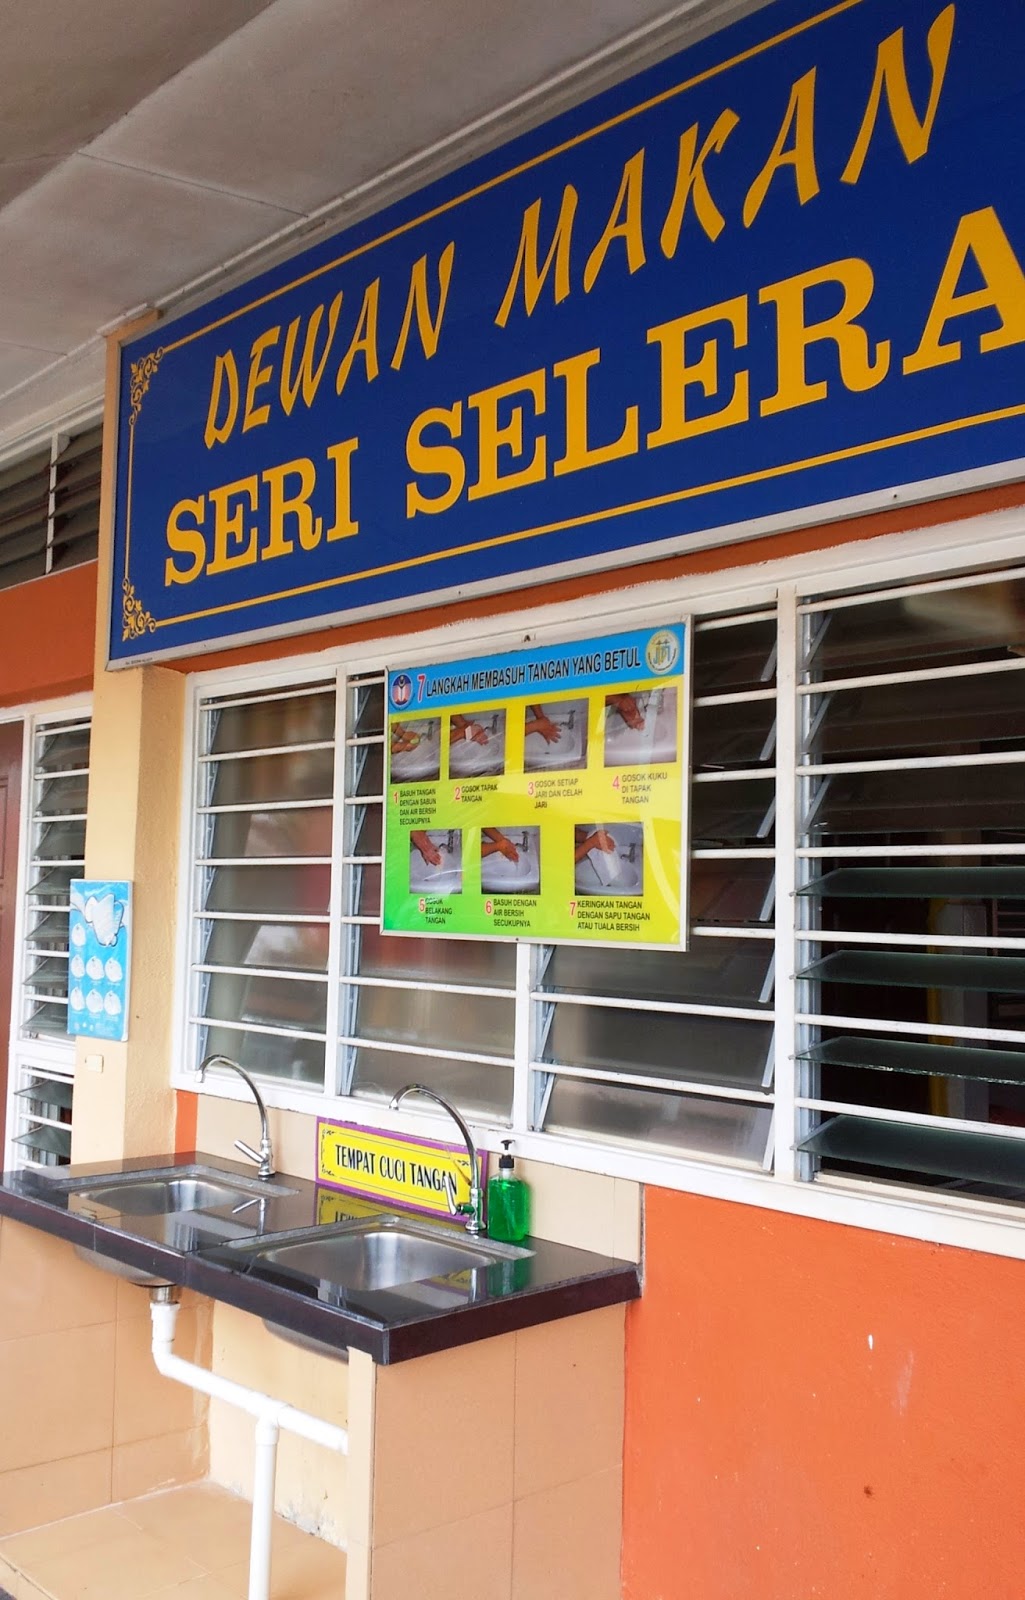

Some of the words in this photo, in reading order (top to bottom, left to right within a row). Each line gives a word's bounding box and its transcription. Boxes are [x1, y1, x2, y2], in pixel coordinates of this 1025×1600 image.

[206, 243, 455, 447] DEWAN
[495, 5, 955, 327] MAKAN
[165, 438, 359, 585] SERI
[406, 207, 1025, 518] SELERA
[418, 674, 426, 702] 7
[426, 675, 469, 697] LANGKAH
[471, 664, 526, 690] MEMBASUH
[528, 658, 570, 681] TANGAN
[572, 653, 601, 675] YANG
[604, 647, 641, 671] BETUL
[612, 775, 620, 790] 4
[622, 774, 646, 783] GOSOK
[648, 772, 668, 780] KUKU
[528, 781, 534, 796] 3
[535, 780, 556, 788] GOSOK
[557, 778, 579, 787] SETIAP
[622, 786, 629, 794] DI
[630, 784, 651, 793] TAPAK
[393, 791, 398, 804] 1
[400, 790, 416, 798] BASUH
[417, 788, 436, 797] TANGAN
[455, 786, 461, 801] 2
[461, 785, 480, 793] GOSOK
[534, 790, 548, 799] JARI
[549, 789, 561, 798] DAN
[563, 788, 583, 797] CELAH
[400, 799, 419, 807] DENGAN
[461, 795, 483, 803] TANGAN
[622, 796, 649, 804] TANGAN
[534, 801, 548, 809] JARI
[400, 808, 410, 816] DAN
[419, 807, 437, 815] BERSIH
[400, 817, 431, 825] SECUKUPNYA
[419, 898, 425, 912] 5
[485, 900, 492, 914] 6
[493, 898, 512, 907] BASUH
[513, 899, 537, 907] DENGAN
[570, 902, 576, 916] 7
[577, 900, 614, 909] KERINGKAN
[615, 900, 643, 909] TANGAN
[425, 907, 453, 915] BELAKANG
[504, 909, 524, 917] BERSIH
[577, 911, 603, 919] DENGAN
[604, 911, 622, 920] SAPU
[623, 912, 651, 920] TANGAN
[493, 919, 531, 927] SECUKUPNYA
[594, 922, 615, 930] TUALA
[616, 923, 640, 931] BERSIH
[335, 1144, 375, 1175] TEMPAT
[379, 1155, 406, 1183] CUCI
[409, 1163, 458, 1196] TANGAN
